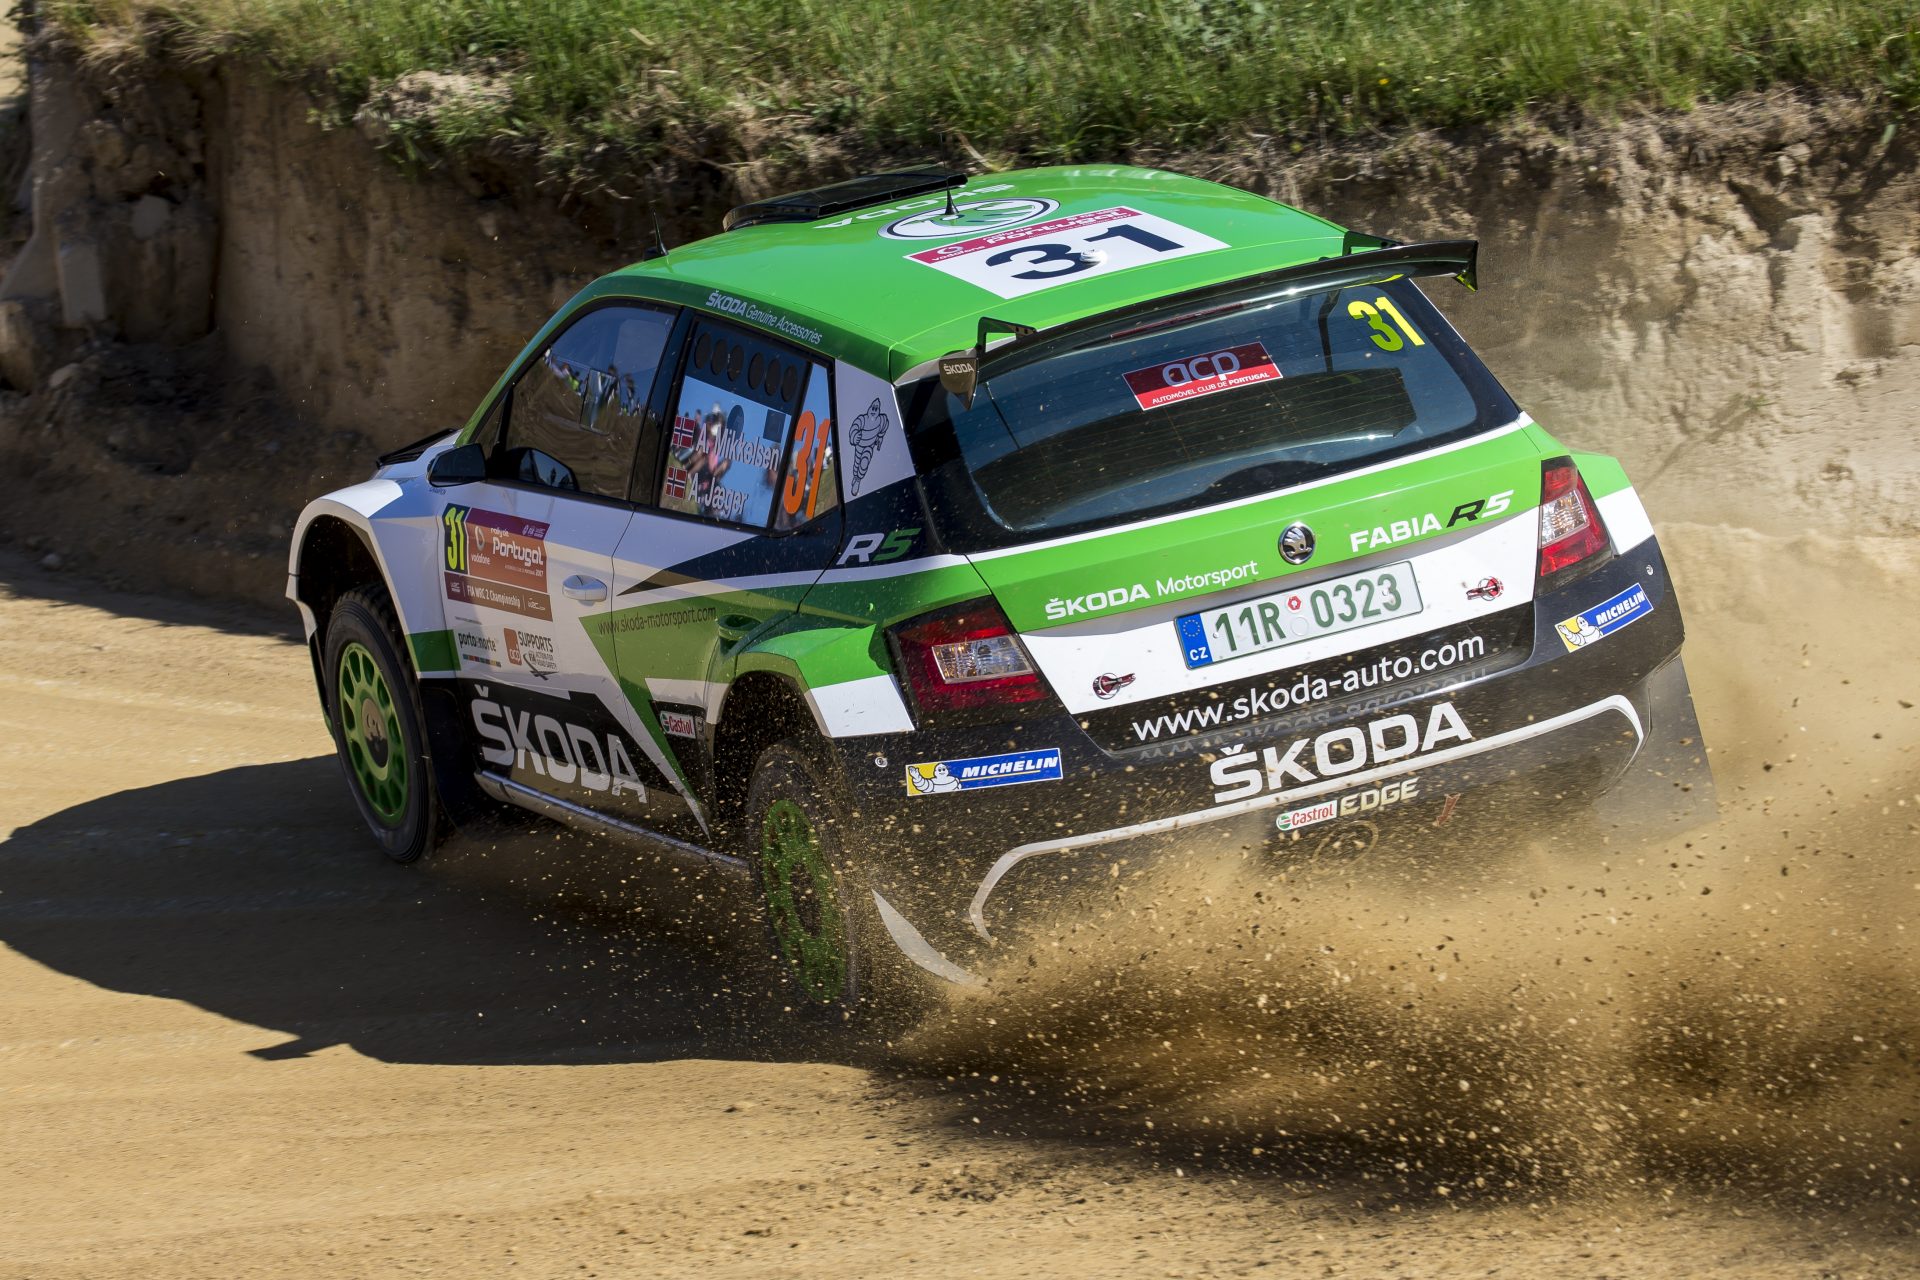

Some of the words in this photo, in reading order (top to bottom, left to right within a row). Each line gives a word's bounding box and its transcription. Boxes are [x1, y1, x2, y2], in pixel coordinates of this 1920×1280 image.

[986, 211, 1130, 244] Portugal
[932, 246, 986, 261] vodafone
[985, 224, 1183, 280] 31
[705, 290, 748, 316] ŠKODA
[746, 304, 777, 327] Genuine
[775, 315, 823, 345] Accessories
[1347, 296, 1425, 352] 31
[943, 362, 975, 375] ŠKODA
[1162, 351, 1240, 384] acp
[1197, 383, 1217, 393] CLUB
[1217, 380, 1228, 389] DE
[1228, 372, 1270, 386] PORTUGAL
[695, 423, 711, 455] A.
[713, 426, 782, 472] Mikkelsen
[783, 410, 831, 520] 31
[704, 477, 750, 519] Jæger
[445, 506, 465, 571] 31
[1350, 512, 1444, 553] FABIA
[1446, 489, 1515, 529] R5
[471, 553, 491, 566] vodafone
[492, 537, 544, 567] Portugal
[836, 528, 922, 565] R5
[485, 589, 490, 600] 2
[489, 590, 521, 610] Championship
[1044, 583, 1151, 621] ŠKODA
[1156, 560, 1259, 596] Motorsport
[1595, 590, 1646, 626] MICHELIN
[598, 607, 717, 635] www.skoda-motorsport.com
[1214, 602, 1287, 652] 11R
[1312, 573, 1403, 629] 0323
[517, 630, 554, 653] SUPPORTS
[1188, 645, 1209, 662] CZ
[1131, 632, 1485, 742] www.skoda-auto.com
[471, 684, 647, 803] ŠKODA
[669, 715, 693, 735] Castrol
[961, 756, 1059, 778] MICHELIN
[1209, 701, 1473, 804] ŠKODA
[1291, 803, 1335, 827] Castrol
[1339, 776, 1421, 817] EDGE
